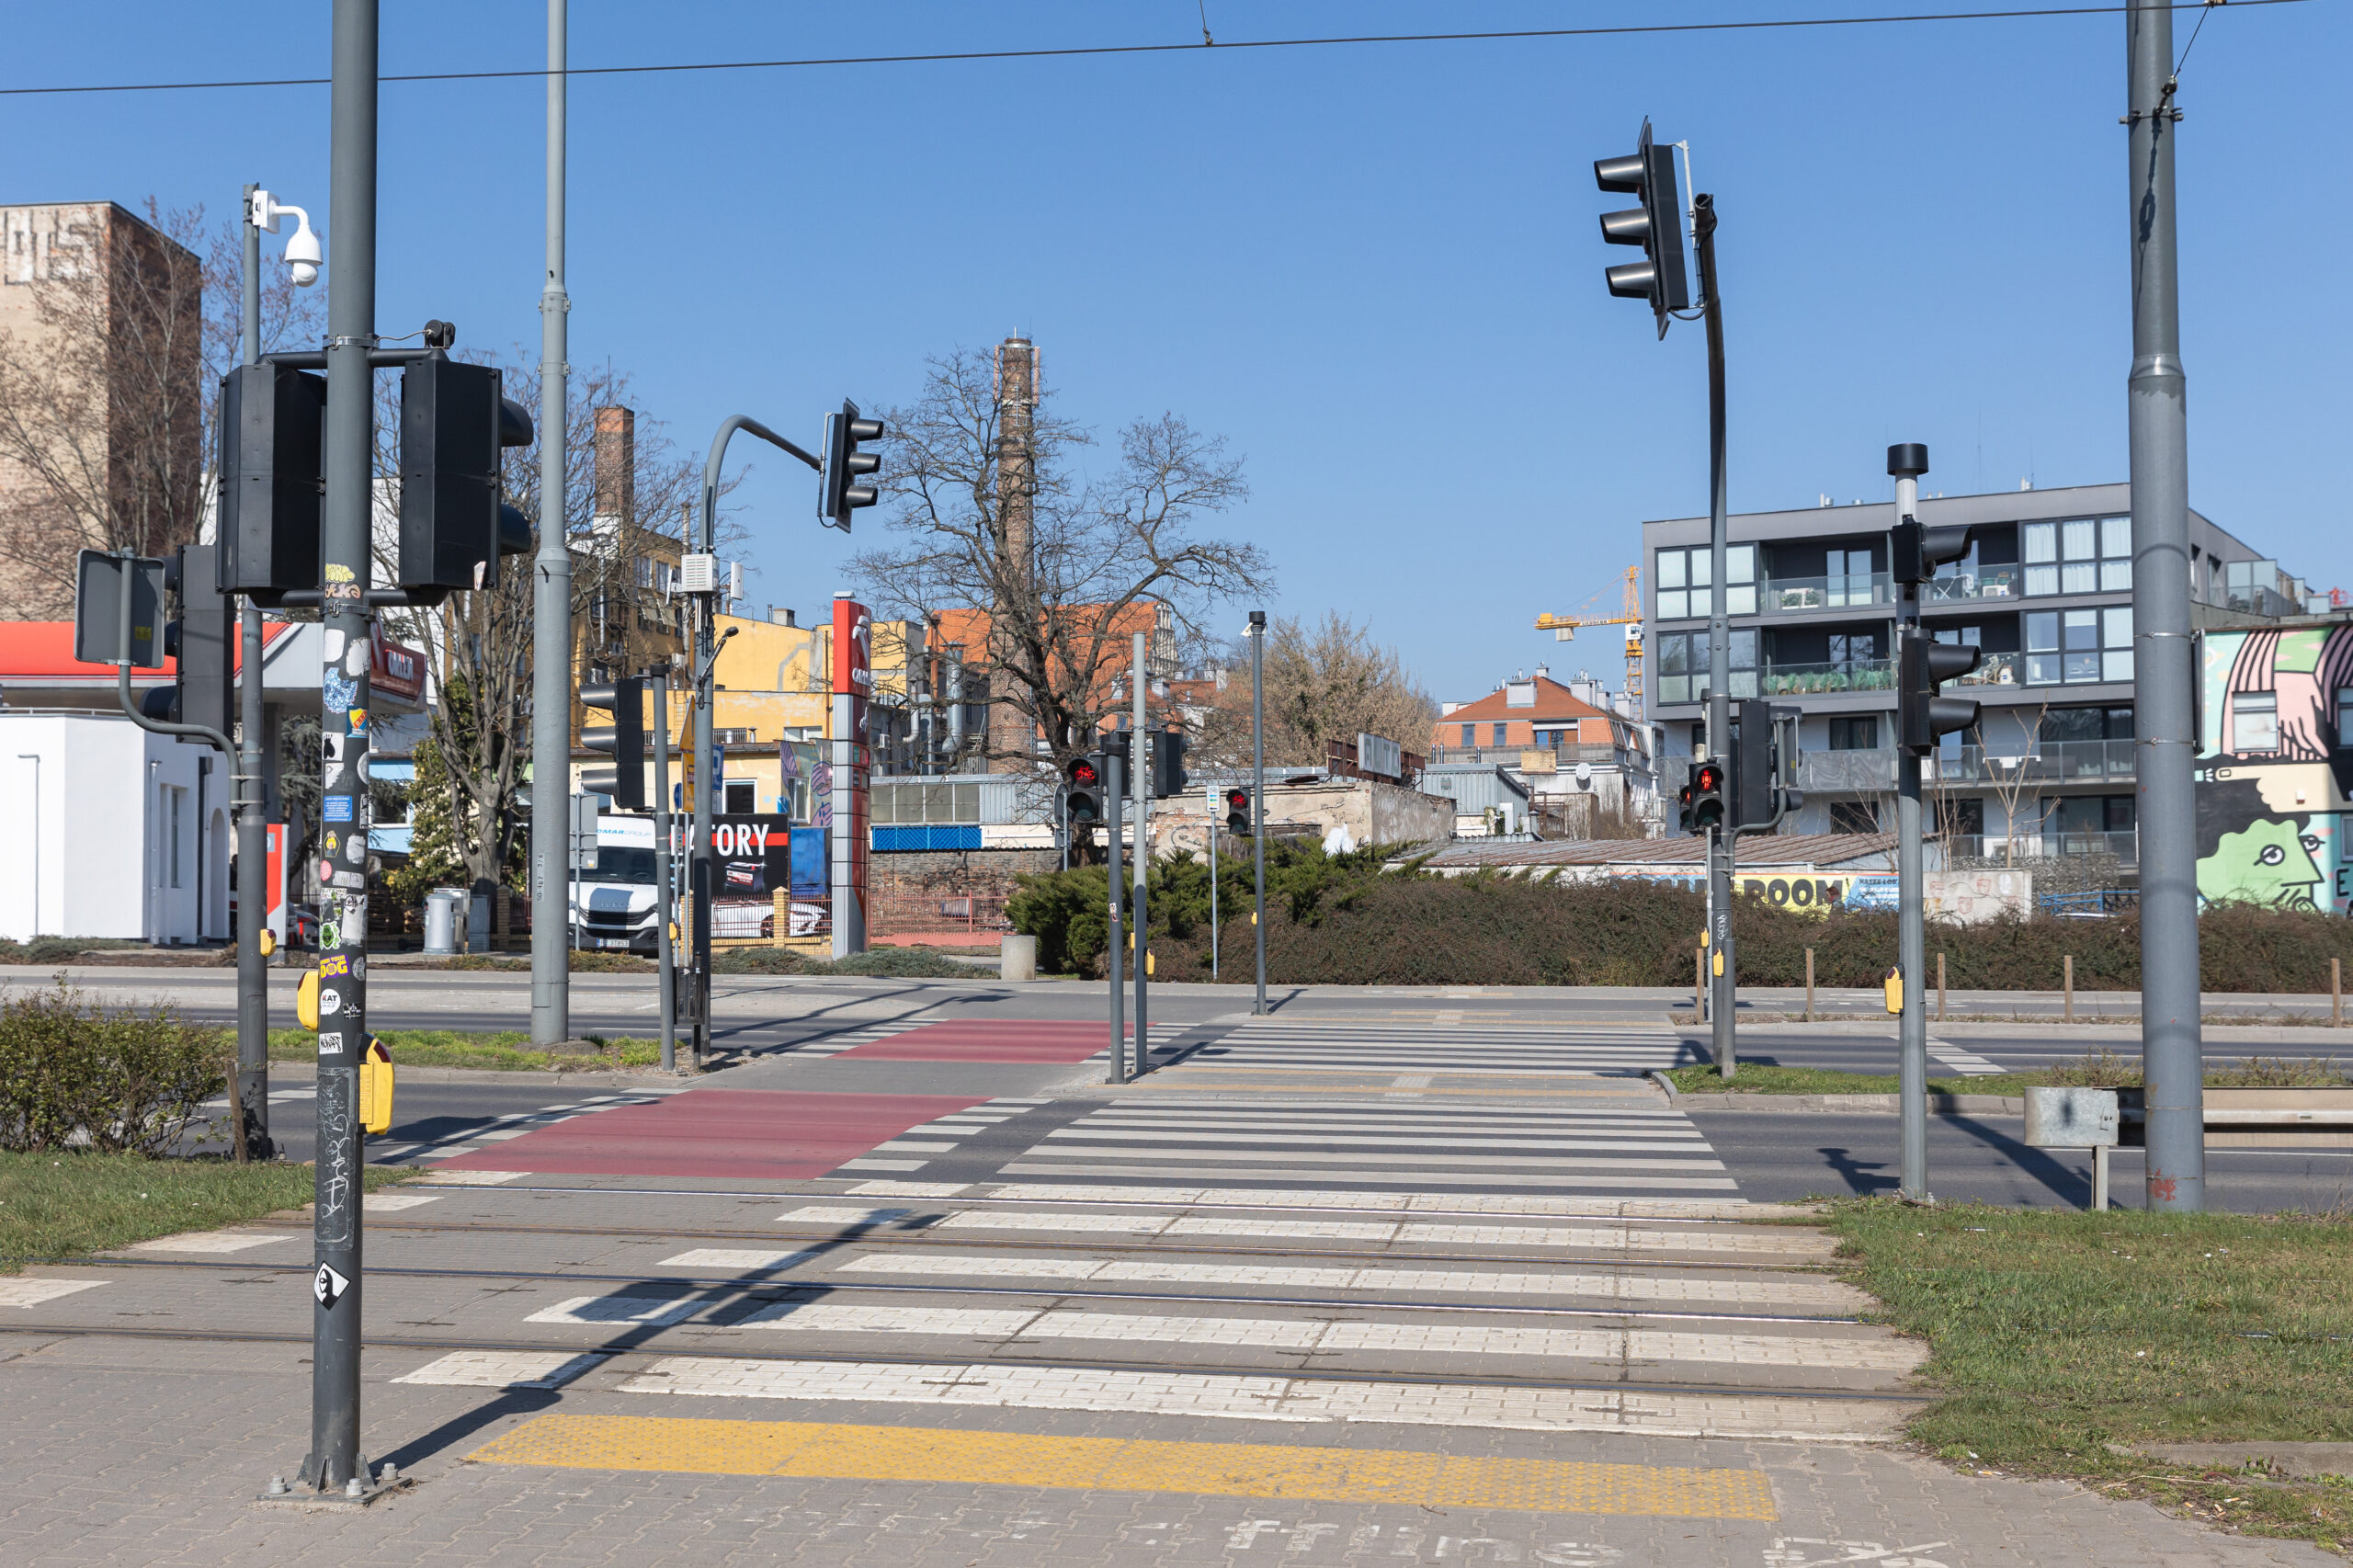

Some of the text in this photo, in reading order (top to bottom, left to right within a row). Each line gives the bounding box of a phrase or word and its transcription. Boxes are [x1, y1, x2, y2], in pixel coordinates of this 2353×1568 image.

[388, 649, 414, 681] ORLEN
[1743, 878, 1844, 908] ROOM
[320, 960, 348, 979] DOG
